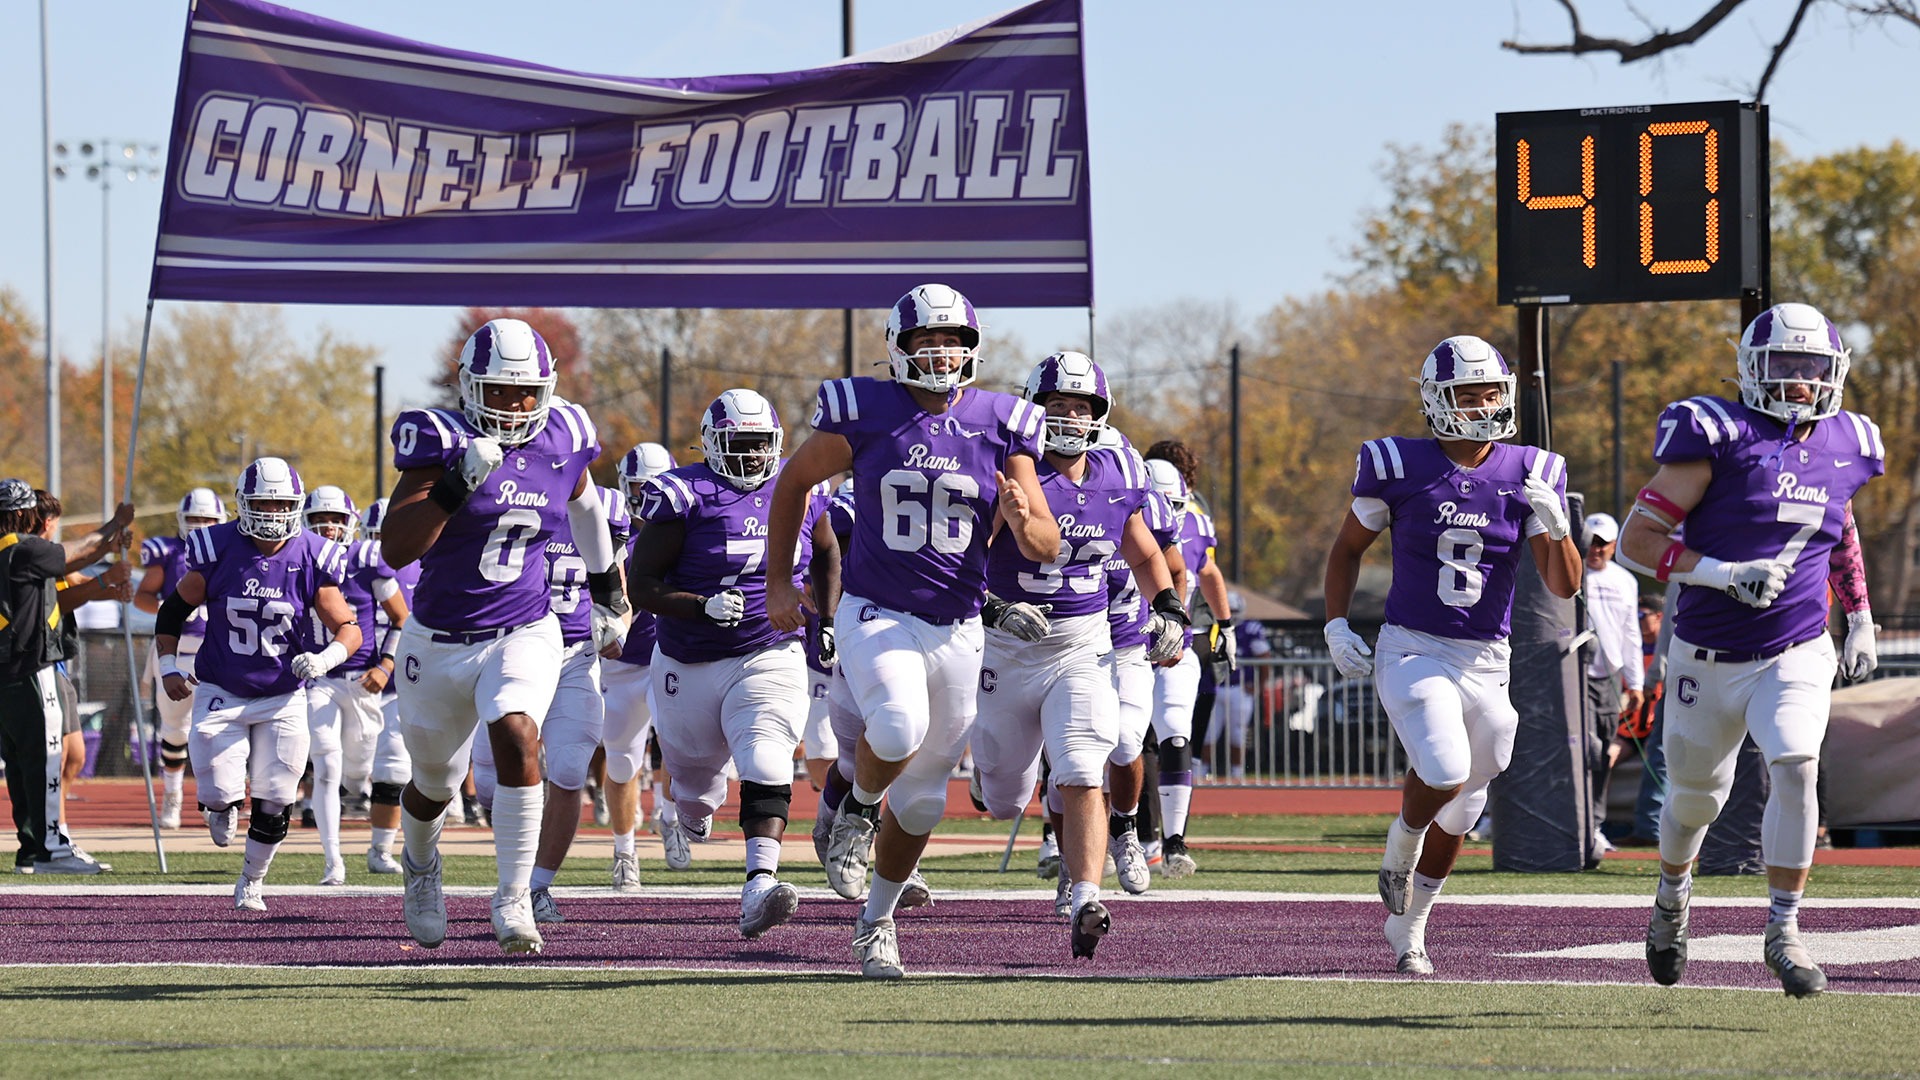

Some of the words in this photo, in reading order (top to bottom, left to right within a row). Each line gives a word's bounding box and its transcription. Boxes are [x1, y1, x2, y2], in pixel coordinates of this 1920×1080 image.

[1580, 105, 1651, 117] DAKTRONICS
[177, 90, 587, 220] CORNELL
[615, 89, 1082, 212] FOOTBALL
[1516, 120, 1719, 275] 40
[398, 421, 418, 457] 0
[1655, 419, 1678, 457] 7
[903, 443, 961, 471] Rams
[495, 479, 549, 507] Rams
[1772, 472, 1830, 504] Rams
[741, 516, 768, 537] Ra
[880, 469, 980, 554] 66
[1057, 513, 1106, 537] Rams
[1433, 500, 1491, 528] Rams
[478, 508, 542, 583] 0
[543, 539, 575, 554] ams
[1772, 501, 1826, 567] 7
[1017, 539, 1117, 595] 33
[1105, 559, 1130, 571] am
[1436, 527, 1484, 608] 8
[242, 578, 284, 599] Rams
[543, 554, 588, 614] 0
[226, 596, 296, 657] 52
[856, 603, 881, 625] C
[404, 652, 421, 684] C
[664, 670, 680, 697] C
[980, 665, 998, 694] C
[207, 696, 225, 712] C
[1676, 674, 1700, 708] C
